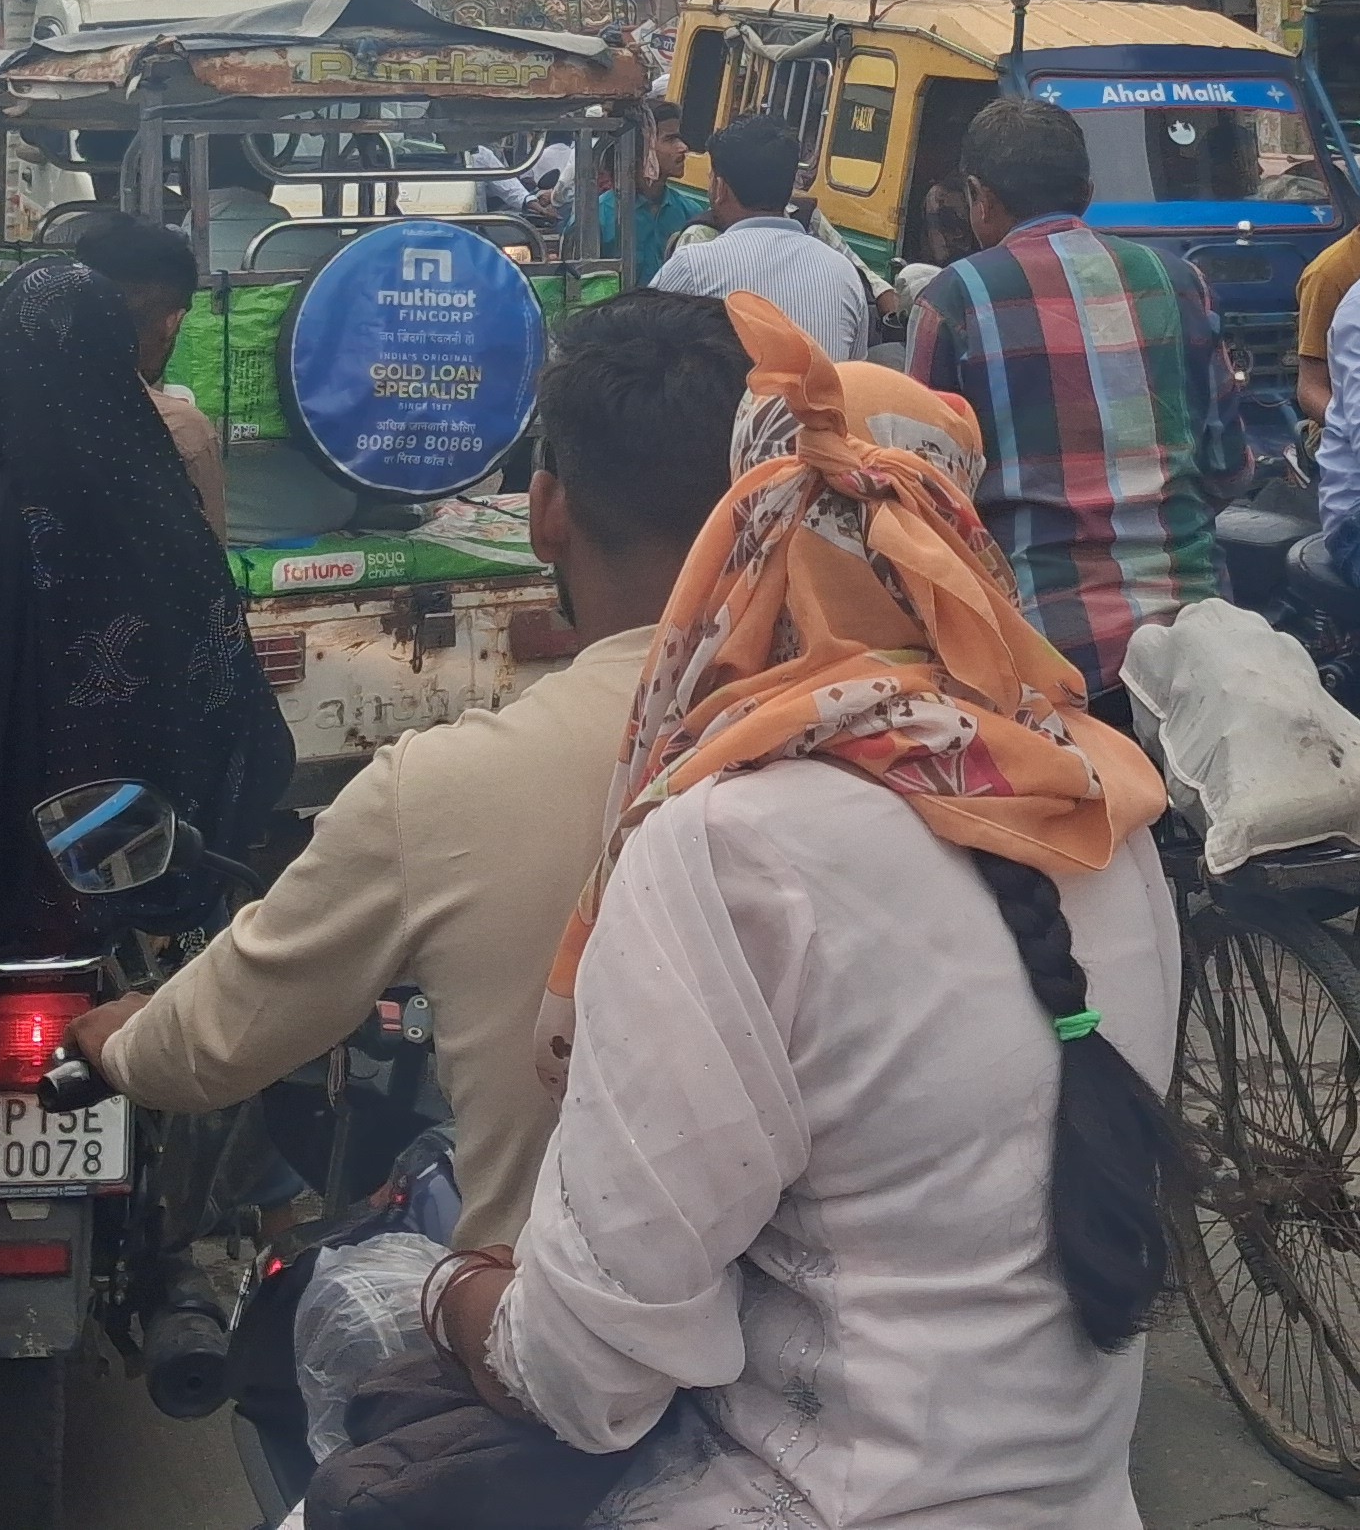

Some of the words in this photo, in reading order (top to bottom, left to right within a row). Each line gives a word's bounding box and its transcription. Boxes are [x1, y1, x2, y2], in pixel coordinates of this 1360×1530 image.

[1102, 82, 1167, 104] Ahad
[1172, 82, 1238, 103] Malik
[378, 288, 477, 308] muthoot
[400, 309, 474, 323] FINCORP
[380, 352, 417, 362] INDIA'S
[423, 353, 474, 363] ORIGINAL
[369, 363, 426, 380] GOLD
[430, 364, 482, 382] LOAN
[373, 380, 480, 400] SPECIALIST
[356, 434, 417, 451] 80869
[424, 434, 483, 452] 80869
[283, 561, 355, 582] fortune
[366, 551, 406, 568] soya
